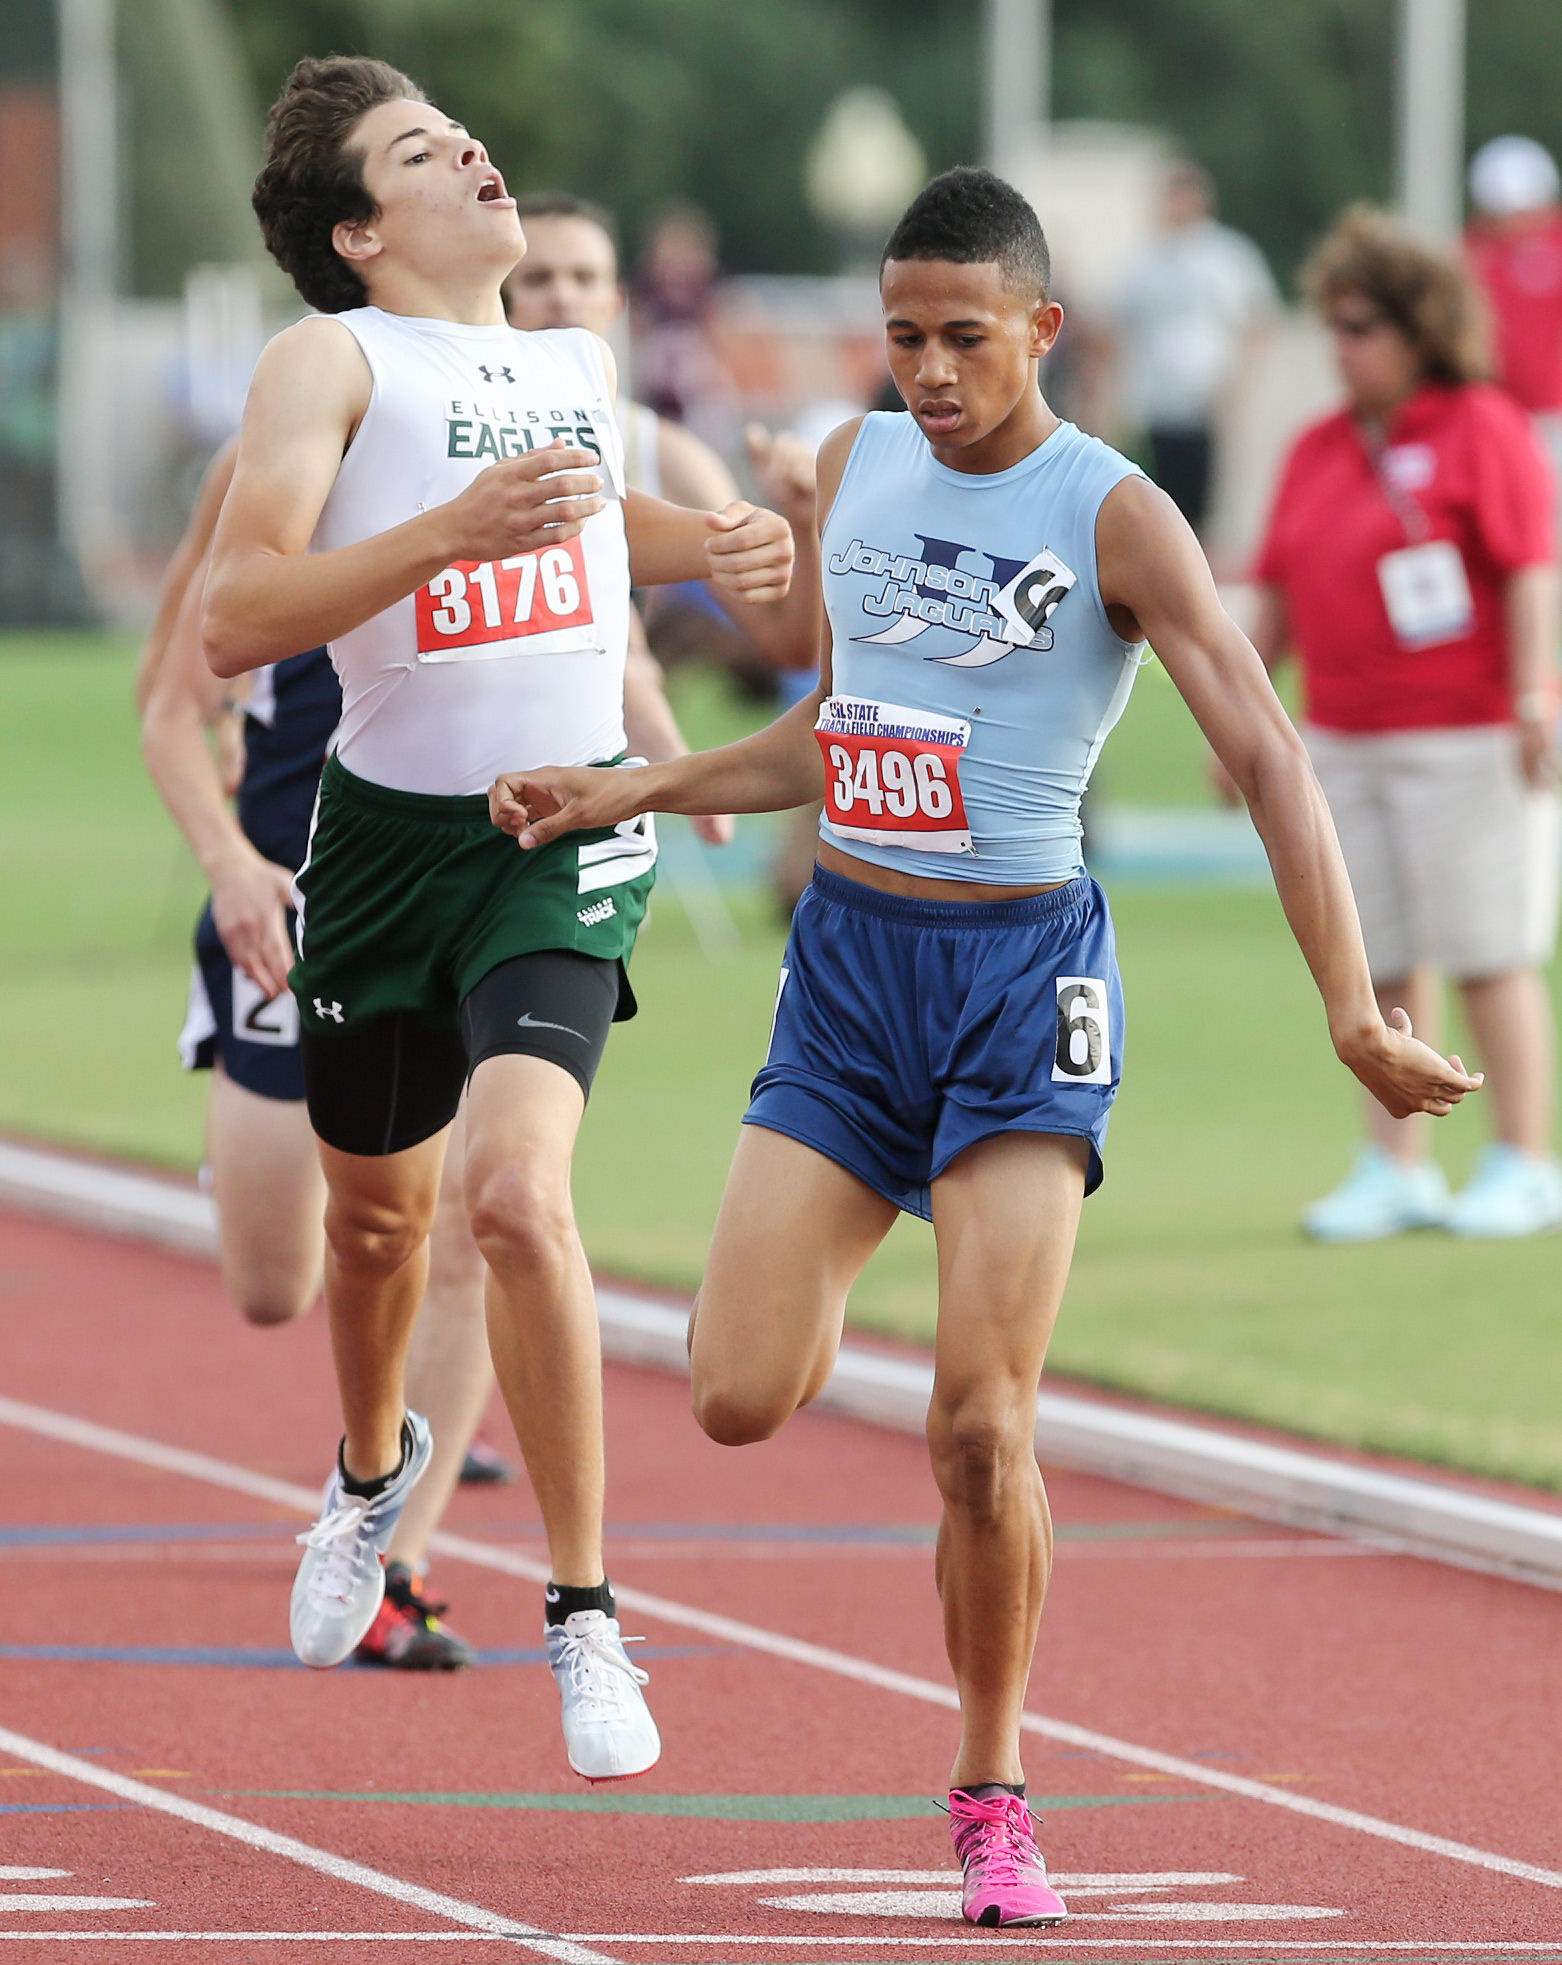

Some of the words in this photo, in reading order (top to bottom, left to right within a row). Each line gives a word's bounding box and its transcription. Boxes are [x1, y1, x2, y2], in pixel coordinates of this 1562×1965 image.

[451, 400, 588, 424] ELLISON
[428, 548, 580, 636] 3176
[862, 582, 1055, 652] JAGUAS
[819, 718, 846, 734] TRACK
[852, 721, 876, 736] FIELD
[877, 723, 965, 747] CHAMPIONSHIPS
[847, 703, 879, 722] STATE
[829, 744, 954, 819] 3496
[1056, 984, 1102, 1077] 6
